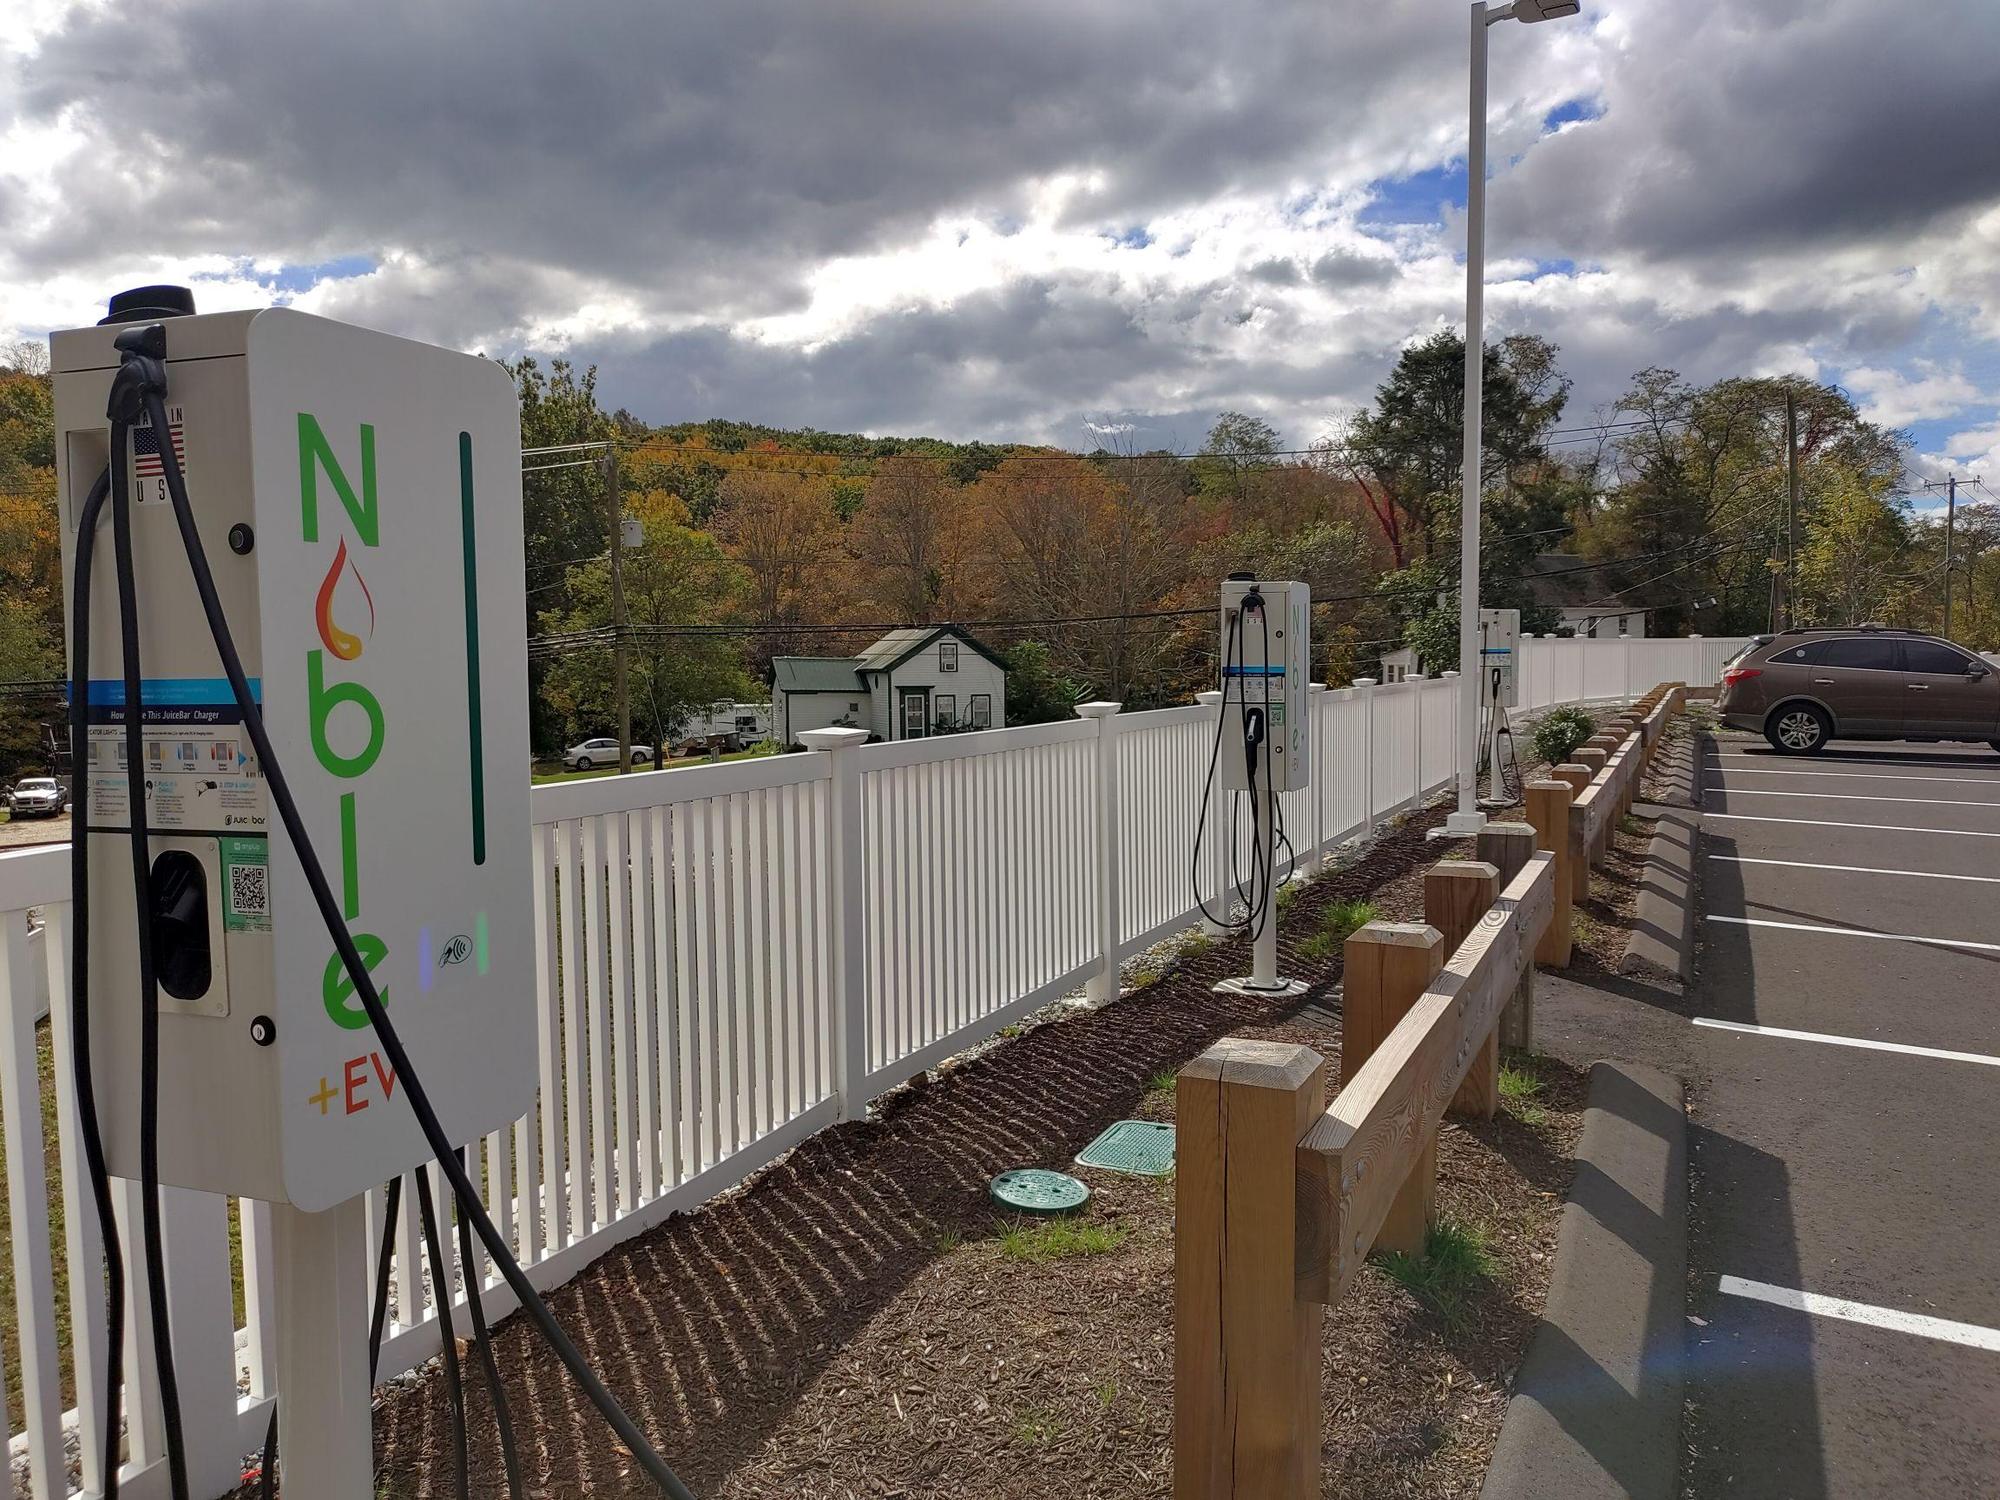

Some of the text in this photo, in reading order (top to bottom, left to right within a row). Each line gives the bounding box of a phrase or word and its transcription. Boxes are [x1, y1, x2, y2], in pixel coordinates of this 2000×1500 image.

[170, 408, 183, 422] IN
[110, 711, 125, 720] How
[147, 710, 161, 720] This
[193, 710, 220, 722] Charger
